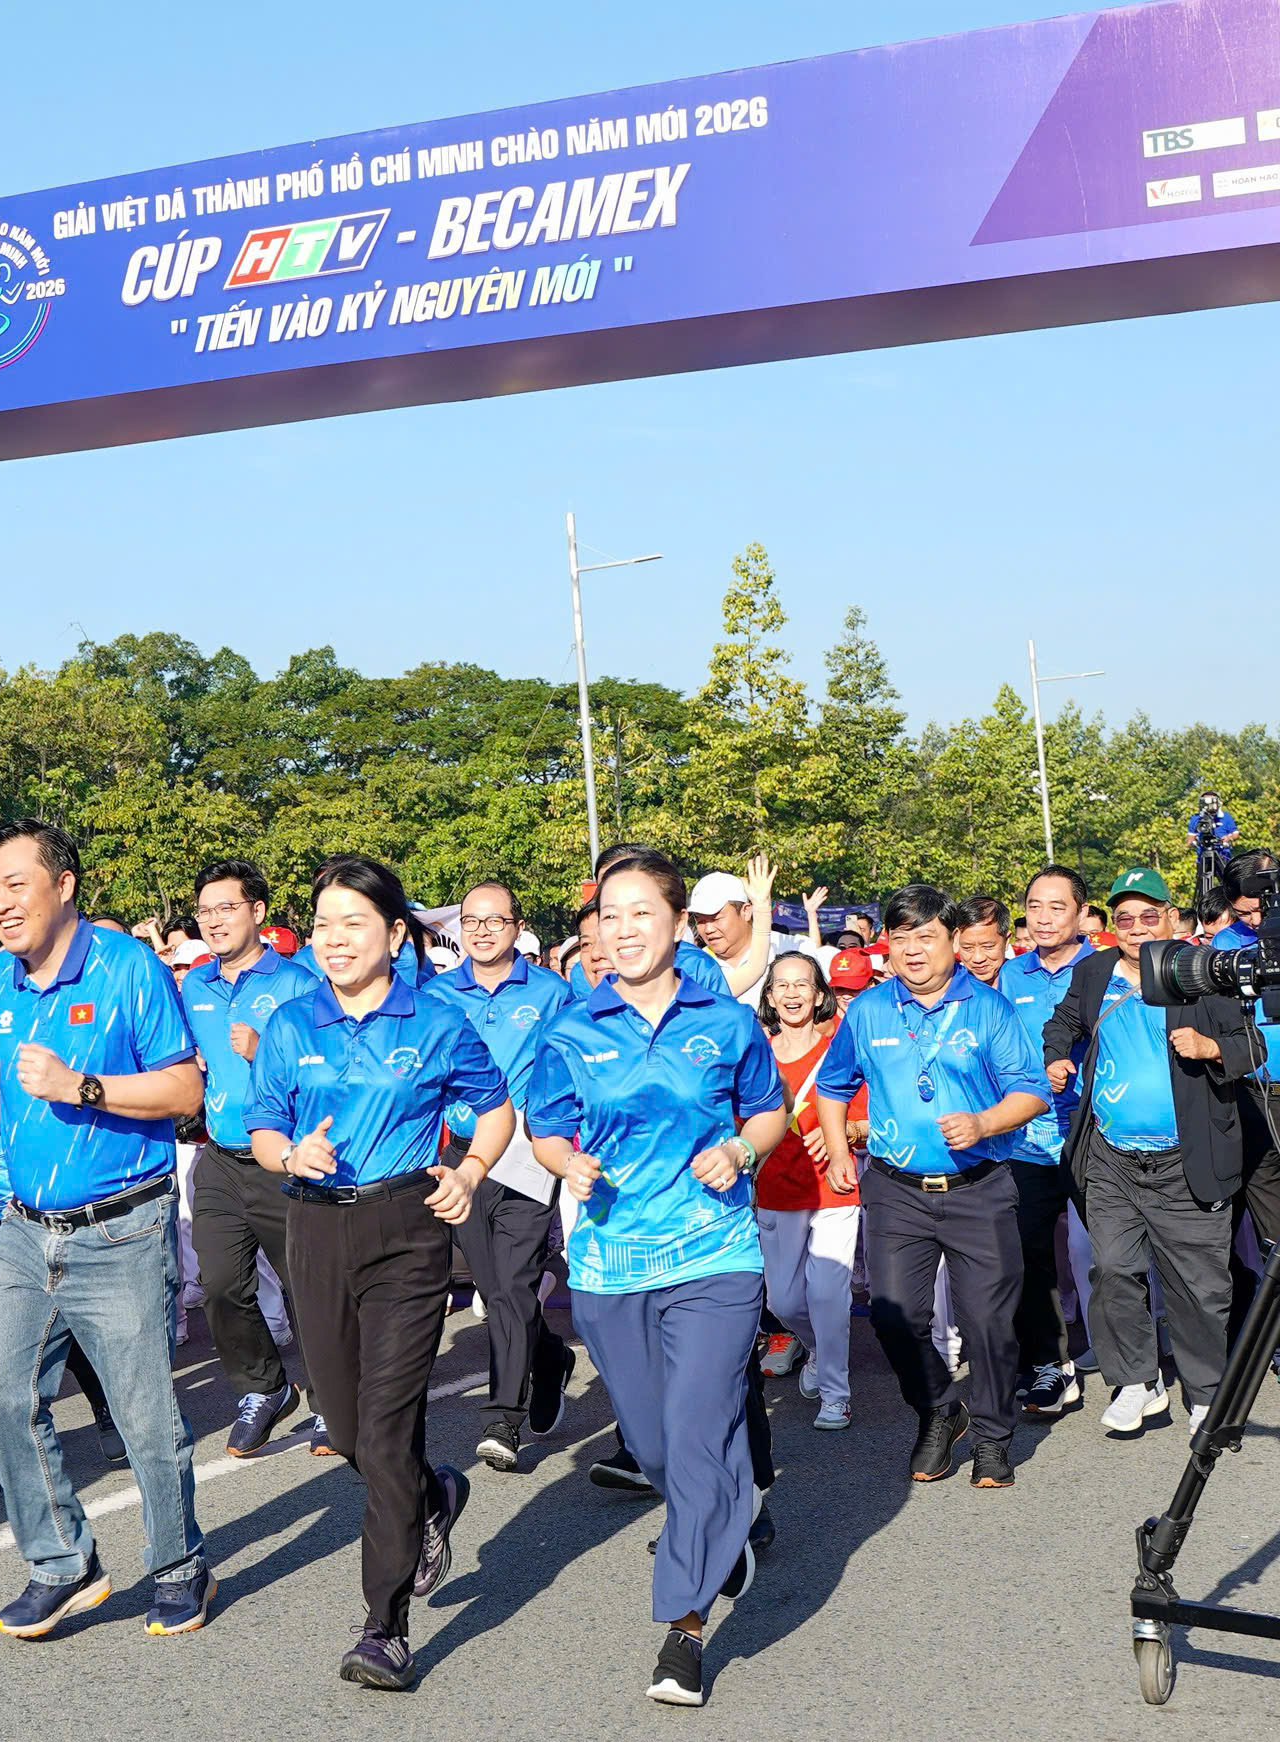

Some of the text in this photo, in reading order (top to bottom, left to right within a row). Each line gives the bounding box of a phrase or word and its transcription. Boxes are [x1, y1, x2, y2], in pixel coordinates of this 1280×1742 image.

[53, 202, 96, 239] GIẢI
[102, 195, 148, 232] VIỆT
[155, 188, 186, 222] DÃ
[192, 178, 269, 215] THÀNH
[276, 160, 324, 202] PHỐ
[331, 152, 363, 193] HỒ
[371, 147, 410, 187] CHÍ
[418, 141, 484, 178] MINH
[491, 127, 559, 168] CHÀO
[566, 117, 628, 155] NĂM
[695, 96, 768, 137] 2026
[1147, 128, 1194, 153] TBS
[0, 241, 28, 270] MINH
[121, 229, 223, 306] CÚP
[234, 221, 377, 278] HTV
[427, 163, 691, 260] BECAMEX
[25, 278, 66, 301] 2026
[195, 299, 263, 352] TIẾN
[268, 294, 333, 342] VÀO
[336, 279, 387, 333] KỶ
[388, 266, 526, 325] NGUYÊN
